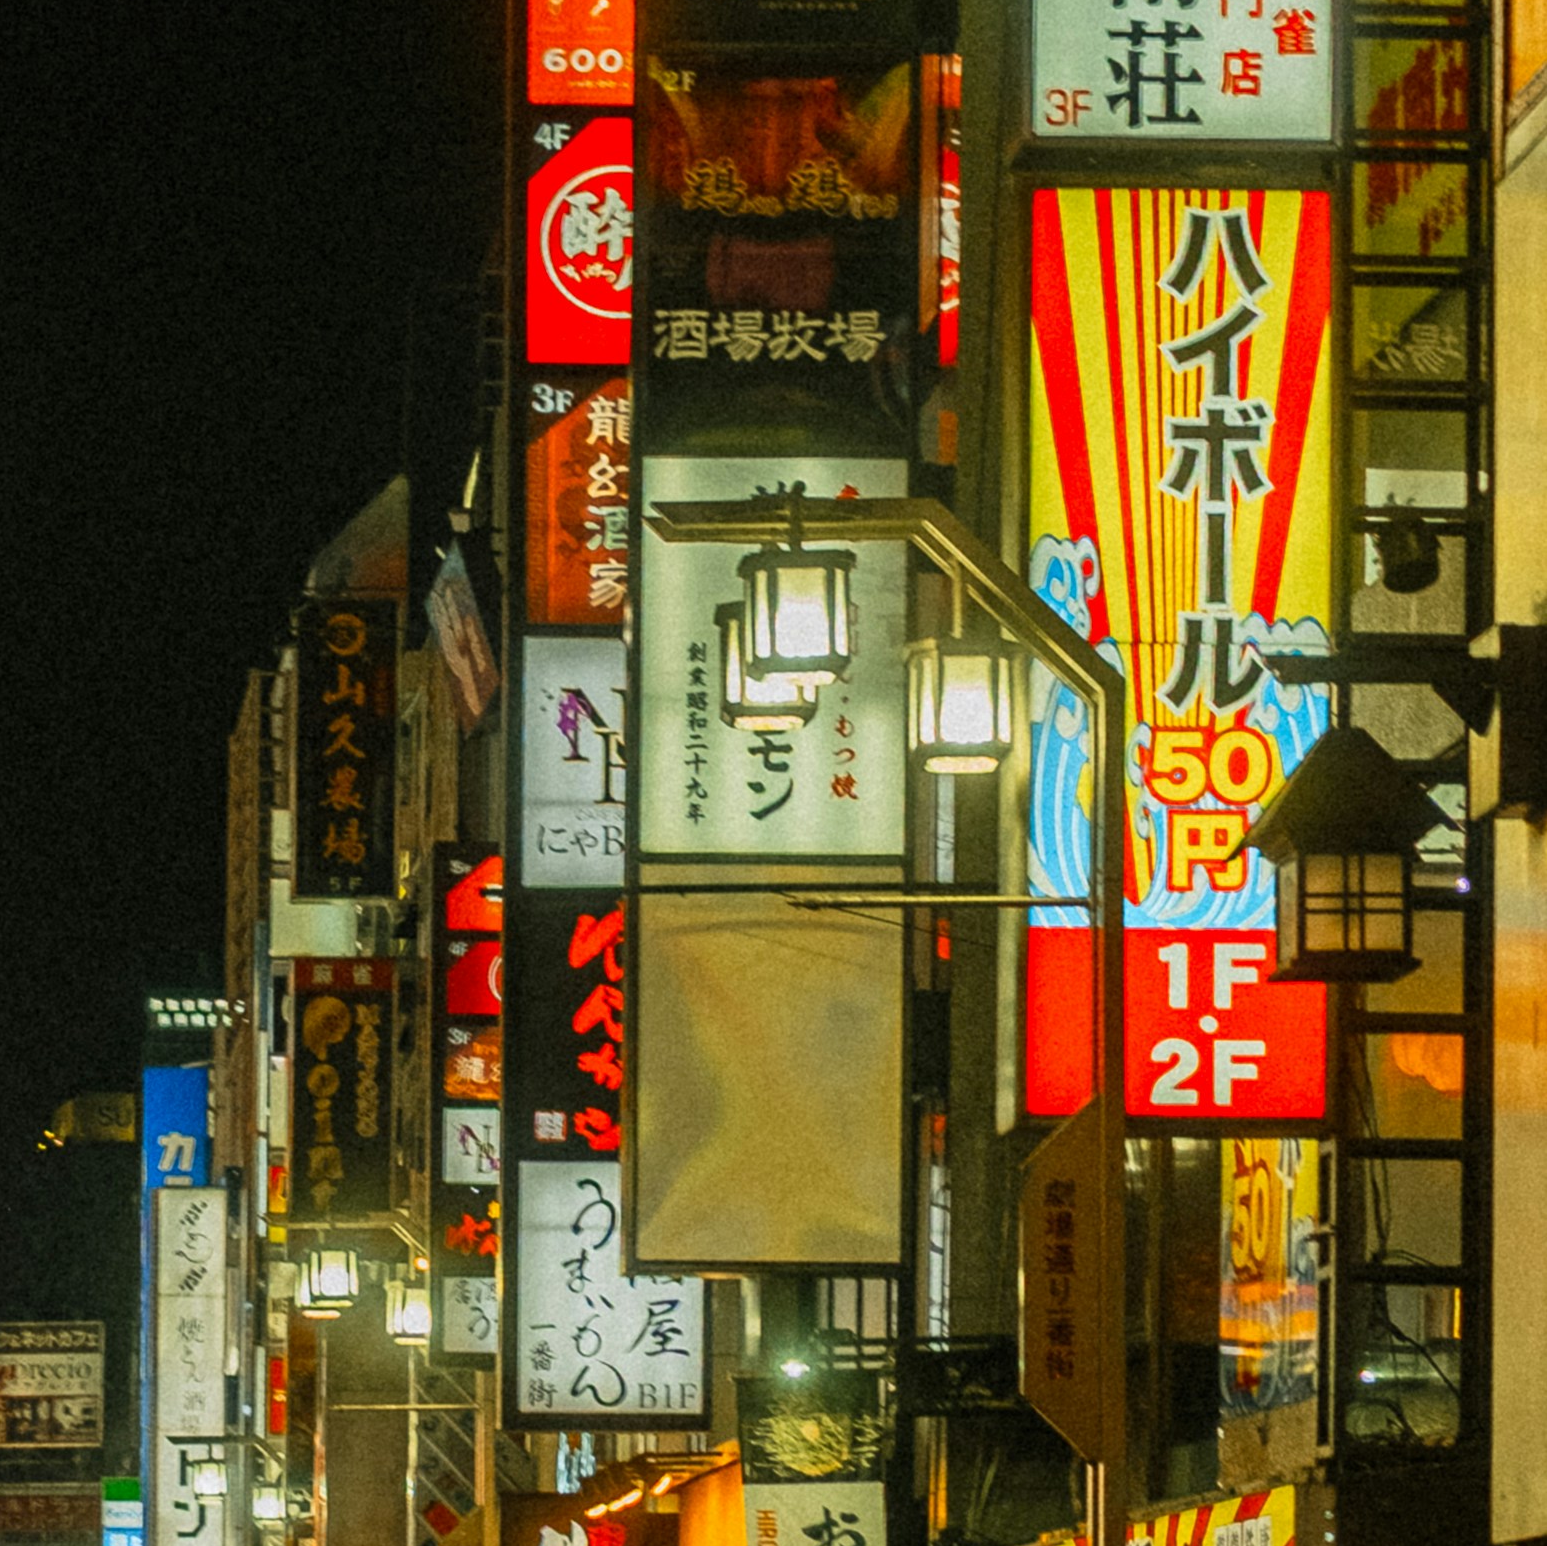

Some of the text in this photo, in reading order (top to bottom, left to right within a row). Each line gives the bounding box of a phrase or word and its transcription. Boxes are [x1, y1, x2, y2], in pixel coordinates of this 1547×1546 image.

[662, 70, 697, 94] 2F
[1043, 88, 1093, 128] 3F
[533, 123, 573, 151] 4F
[654, 308, 888, 363] 酒場牧場
[532, 382, 575, 414] 3F
[1157, 205, 1275, 719] ハイボール
[684, 641, 709, 825] 創業昭和二十九年
[1150, 726, 1272, 806] 50
[1167, 807, 1250, 894] 円
[1157, 942, 1268, 1011] 1F
[1149, 1037, 1268, 1107] 2F
[561, 1177, 627, 1408] うまいもん
[630, 1277, 691, 1357] 屋
[637, 1382, 699, 1410] B1F
